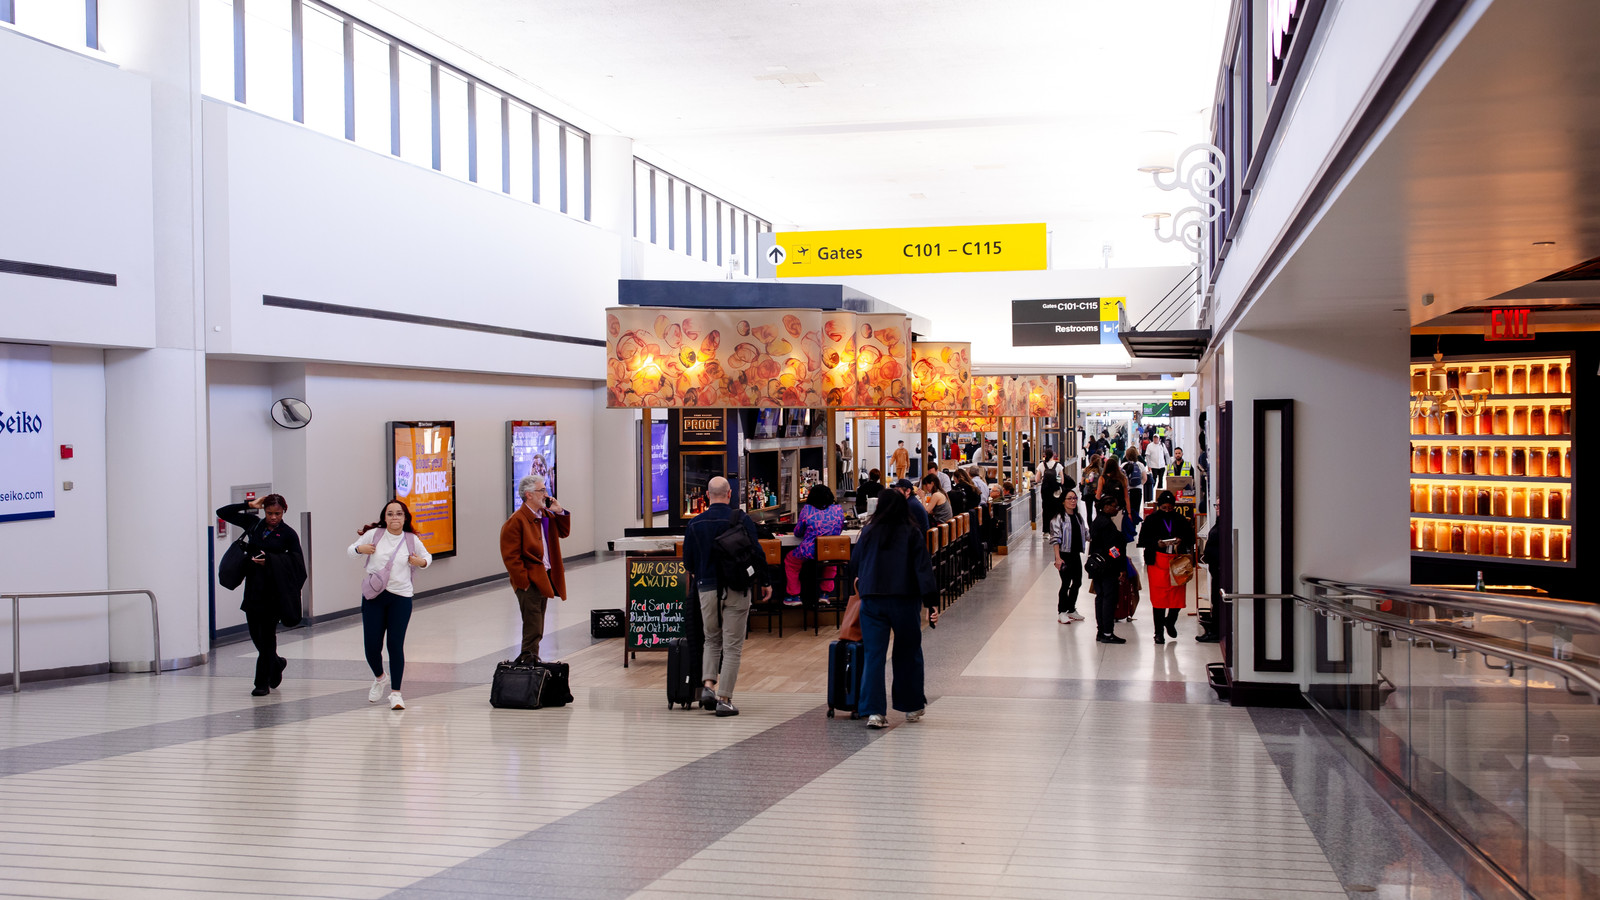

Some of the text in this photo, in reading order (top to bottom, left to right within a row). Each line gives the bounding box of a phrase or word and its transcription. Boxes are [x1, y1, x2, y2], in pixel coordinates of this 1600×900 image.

[818, 246, 863, 260] Gates
[903, 243, 941, 257] C101
[962, 241, 1002, 256] C115
[1057, 302, 1098, 311] C101-C115
[1055, 325, 1099, 333] Restrooms
[1491, 309, 1531, 338] EXIT
[684, 419, 720, 430] PROOF
[634, 575, 678, 587] AWAITS
[631, 599, 683, 614] Red Sangria
[630, 611, 685, 626] Blackberry Bramble
[635, 634, 652, 648] Bay
